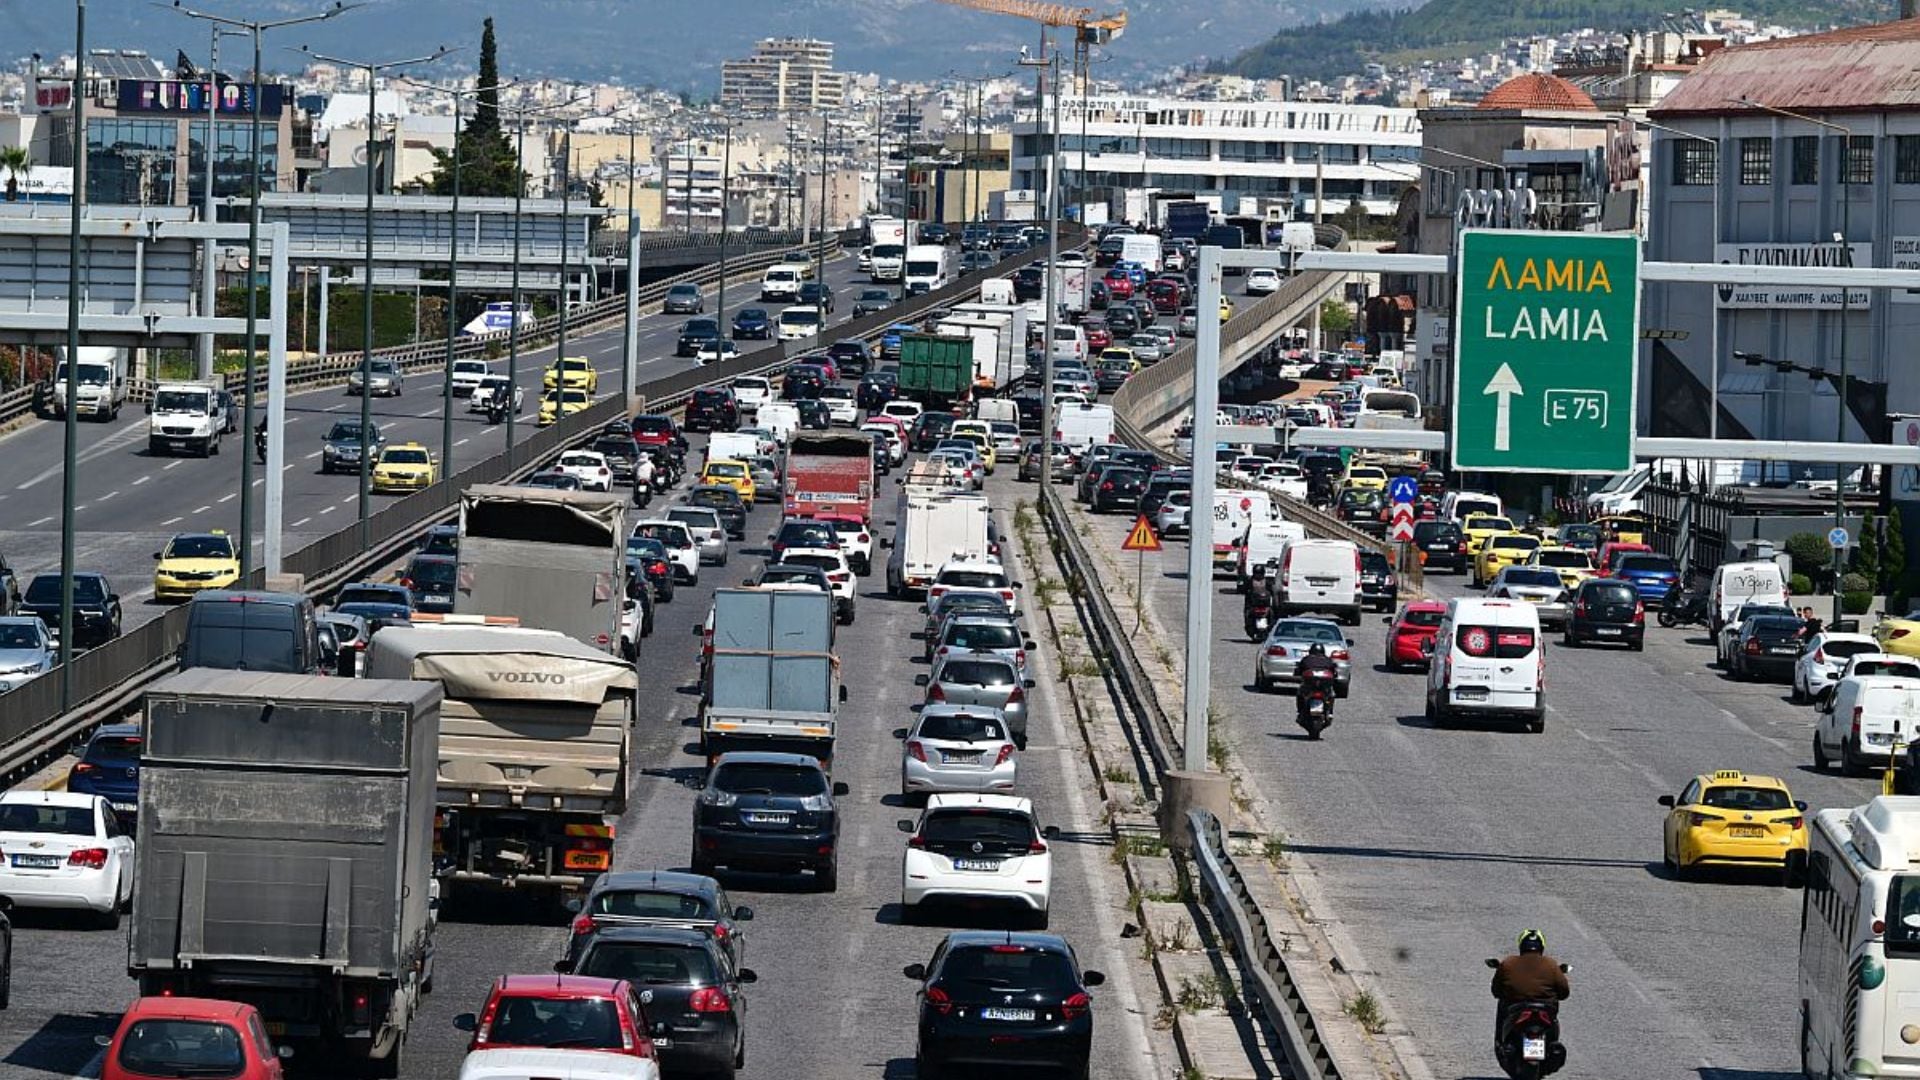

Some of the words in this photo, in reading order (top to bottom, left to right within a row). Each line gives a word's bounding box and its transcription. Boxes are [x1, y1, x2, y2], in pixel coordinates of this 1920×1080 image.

[1487, 257, 1613, 293] ΛΑΜΙΑ
[1485, 305, 1609, 342] LAMIA
[486, 672, 565, 684] VOLVO
